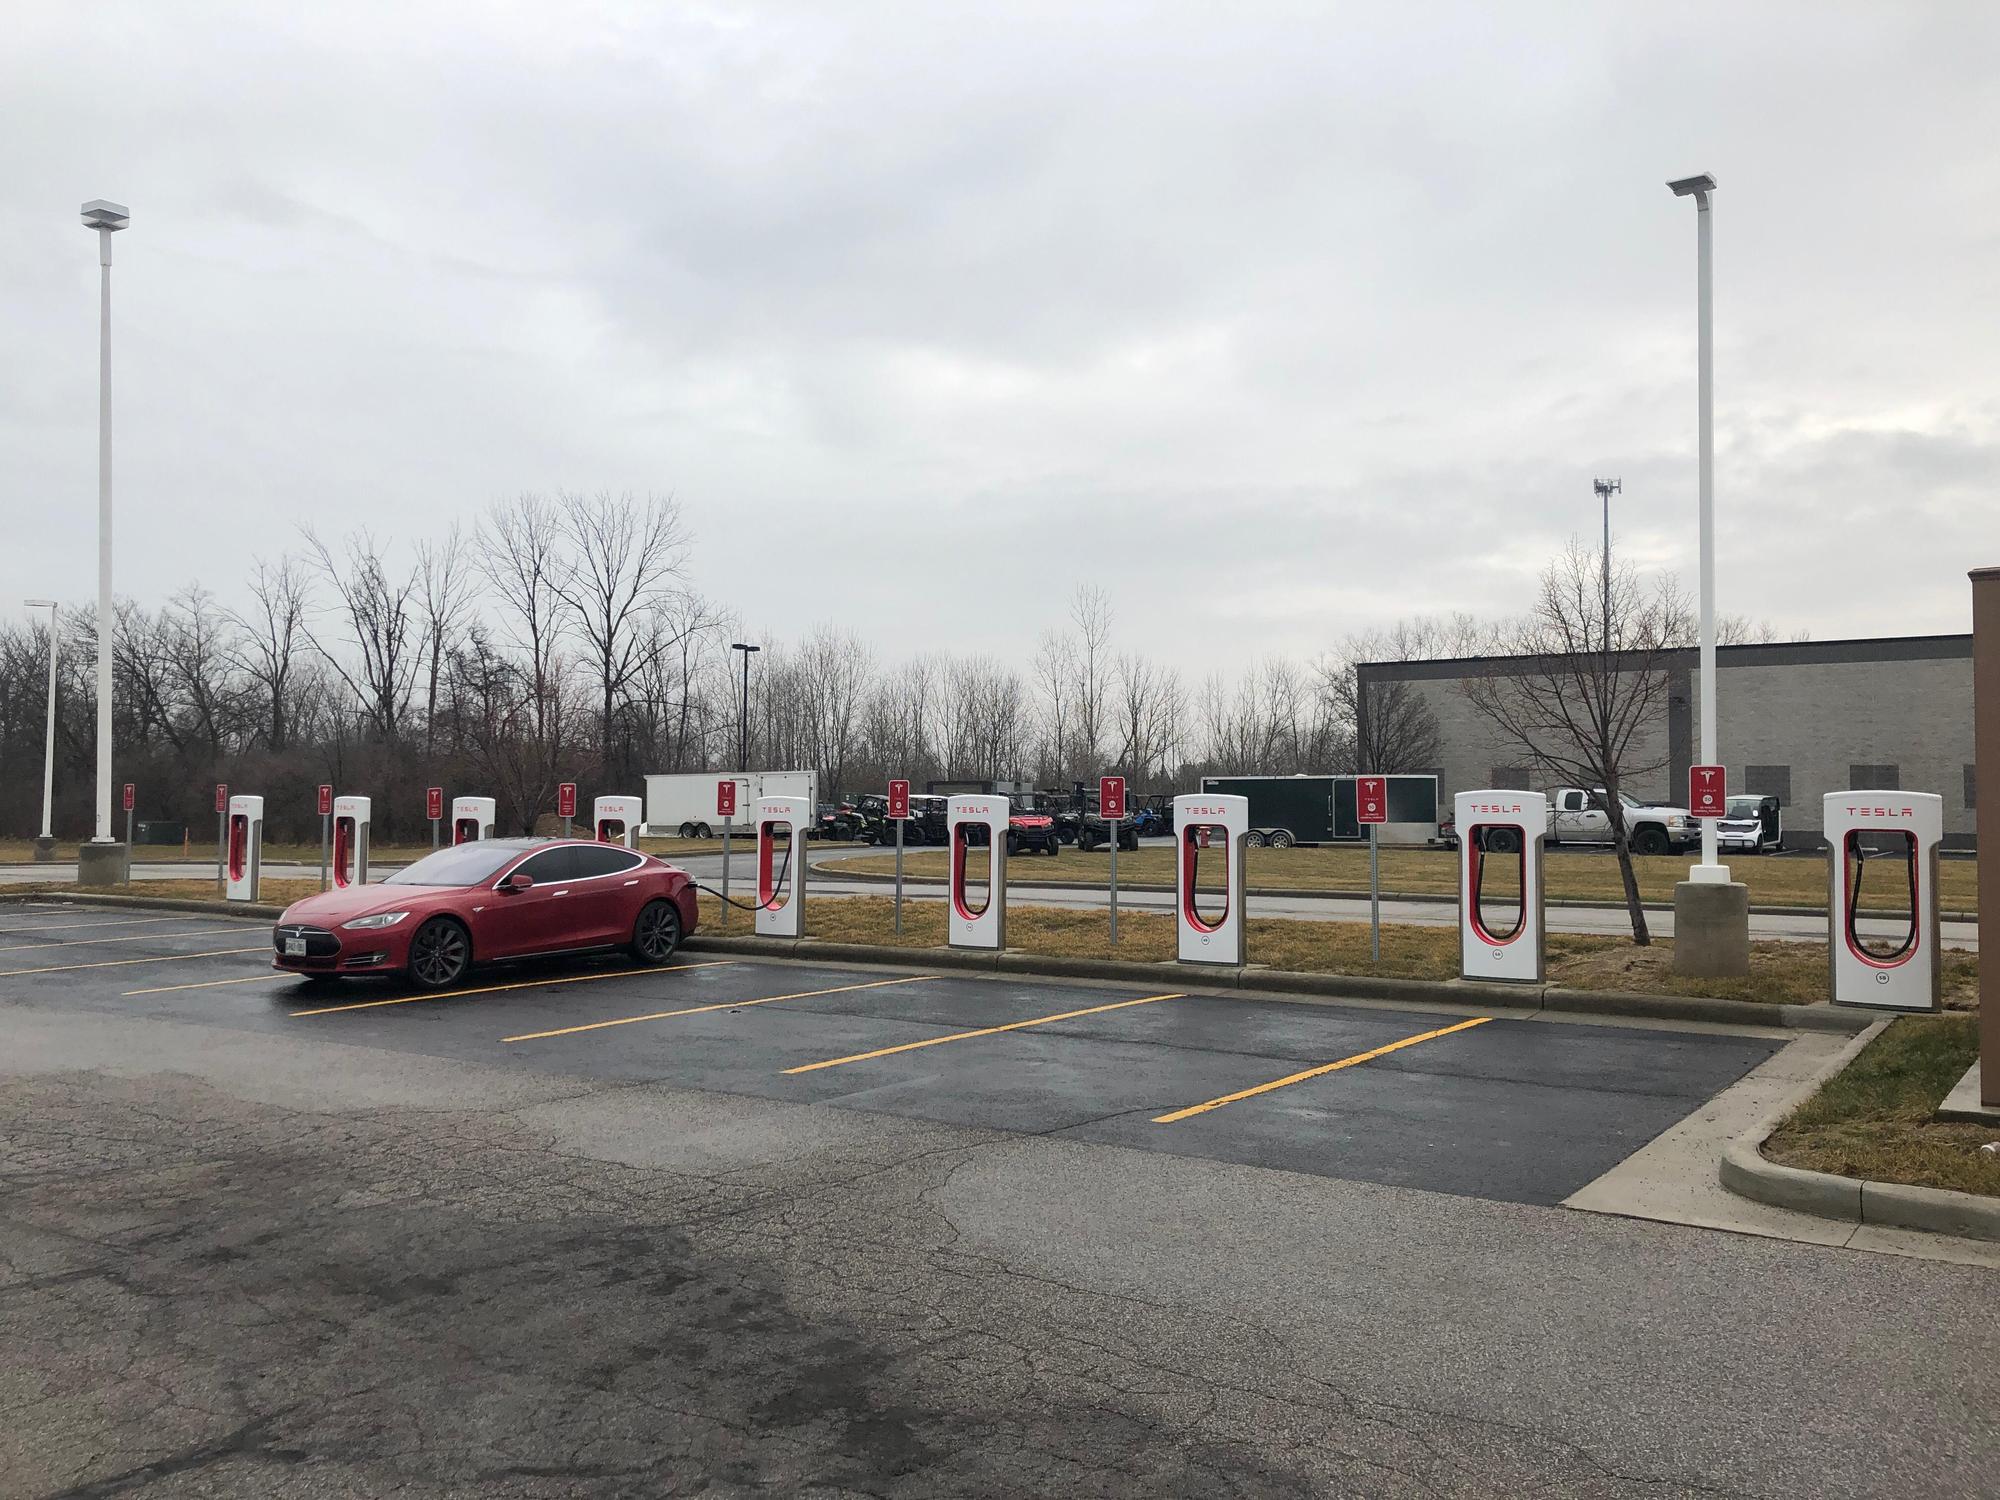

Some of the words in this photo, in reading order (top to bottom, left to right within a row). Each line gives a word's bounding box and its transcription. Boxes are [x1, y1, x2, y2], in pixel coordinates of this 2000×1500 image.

[762, 806, 791, 814] TESLA
[956, 806, 989, 814] TESLA
[1185, 807, 1226, 815] TESLA
[1470, 805, 1521, 813] TESLA
[1846, 807, 1912, 817] TESLA
